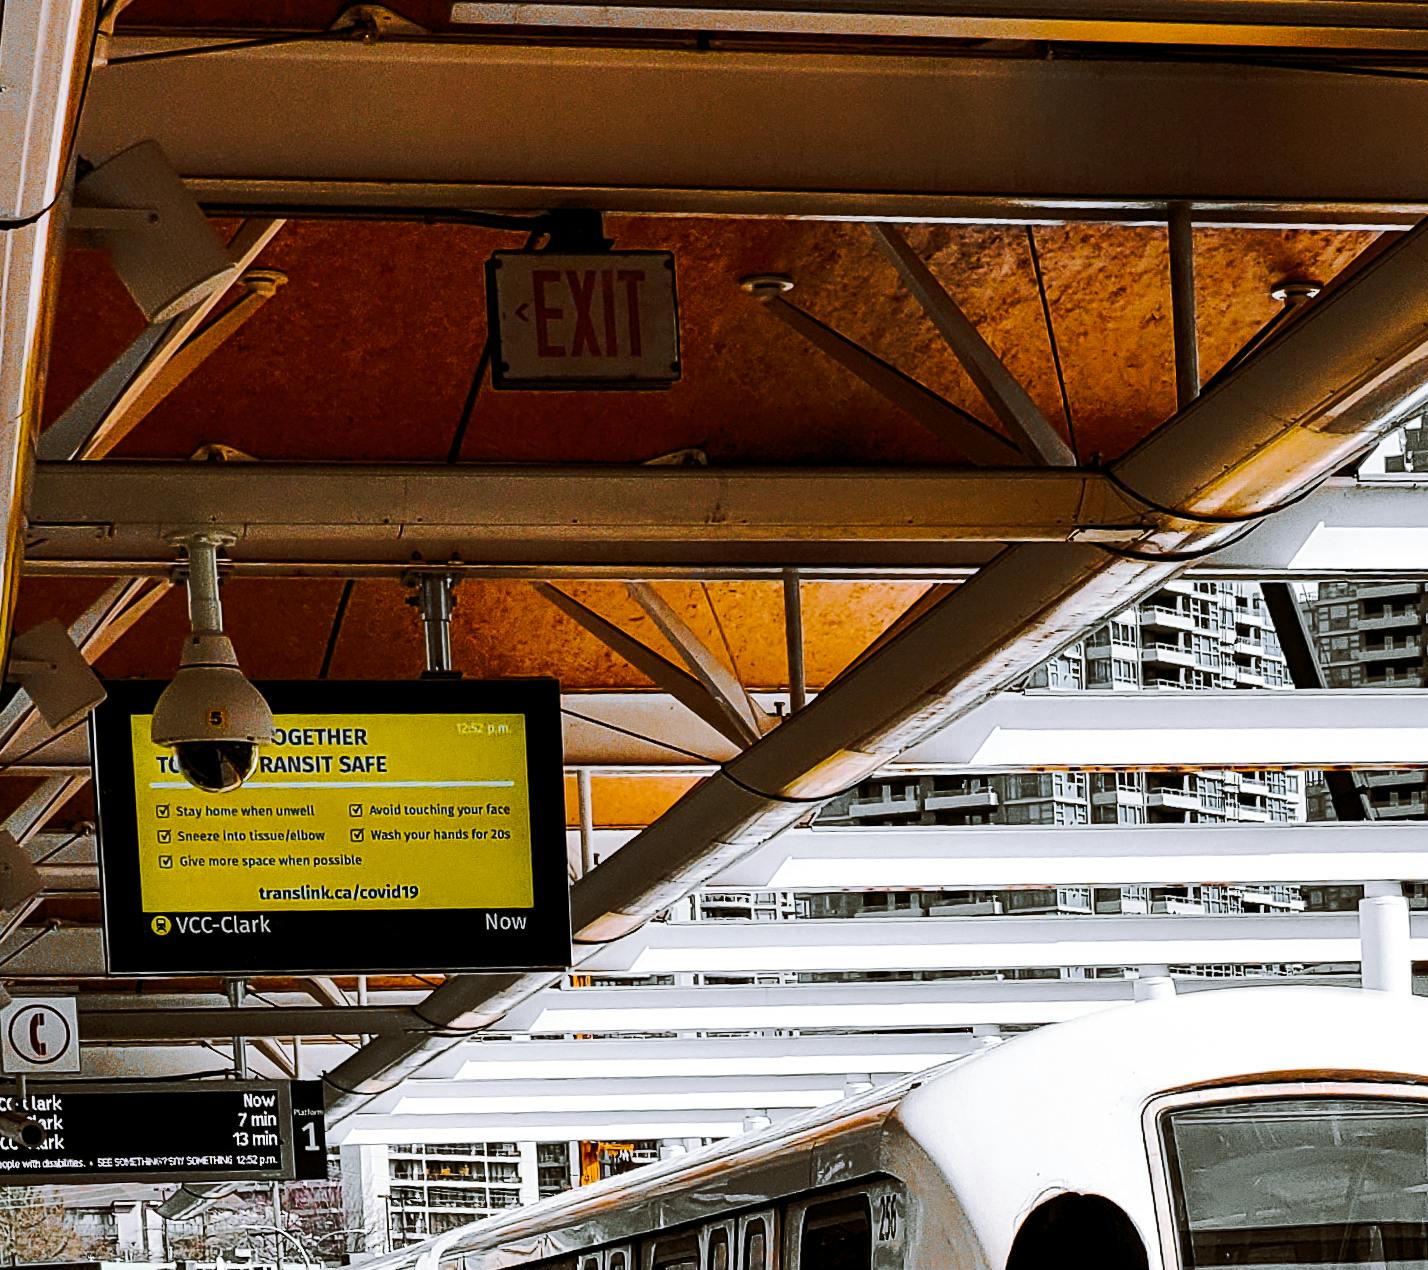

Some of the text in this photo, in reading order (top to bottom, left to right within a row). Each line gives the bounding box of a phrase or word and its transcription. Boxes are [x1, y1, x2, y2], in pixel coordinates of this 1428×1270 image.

[532, 269, 645, 358] EXIT
[210, 711, 223, 726] 5
[273, 728, 368, 746] OGETHER
[456, 723, 512, 736] 12:52 p.m.
[260, 756, 333, 773] RANSIT
[339, 755, 387, 773] SAFE
[176, 804, 315, 818] Stay home when unwell
[369, 803, 511, 818] Avoid touching your face
[177, 829, 325, 843] Sneeze into tissue/elbow
[370, 828, 511, 843] Wash your hands for 20s
[180, 854, 363, 868] Give more space when possible
[258, 884, 419, 901] translink.ca/covid19
[175, 914, 272, 934] VCC-Clark
[485, 912, 527, 931] Now
[243, 1093, 275, 1108] Now
[237, 1110, 277, 1127] 7 min
[293, 1108, 324, 1116] Platform
[232, 1130, 278, 1146] 13 min
[301, 1122, 320, 1151] 1
[22, 1159, 41, 1169] with
[97, 1157, 113, 1167] SEE
[186, 1155, 233, 1166] SOMETHING
[236, 1154, 278, 1166] 12:52 p.m.
[879, 1193, 897, 1241] 256
